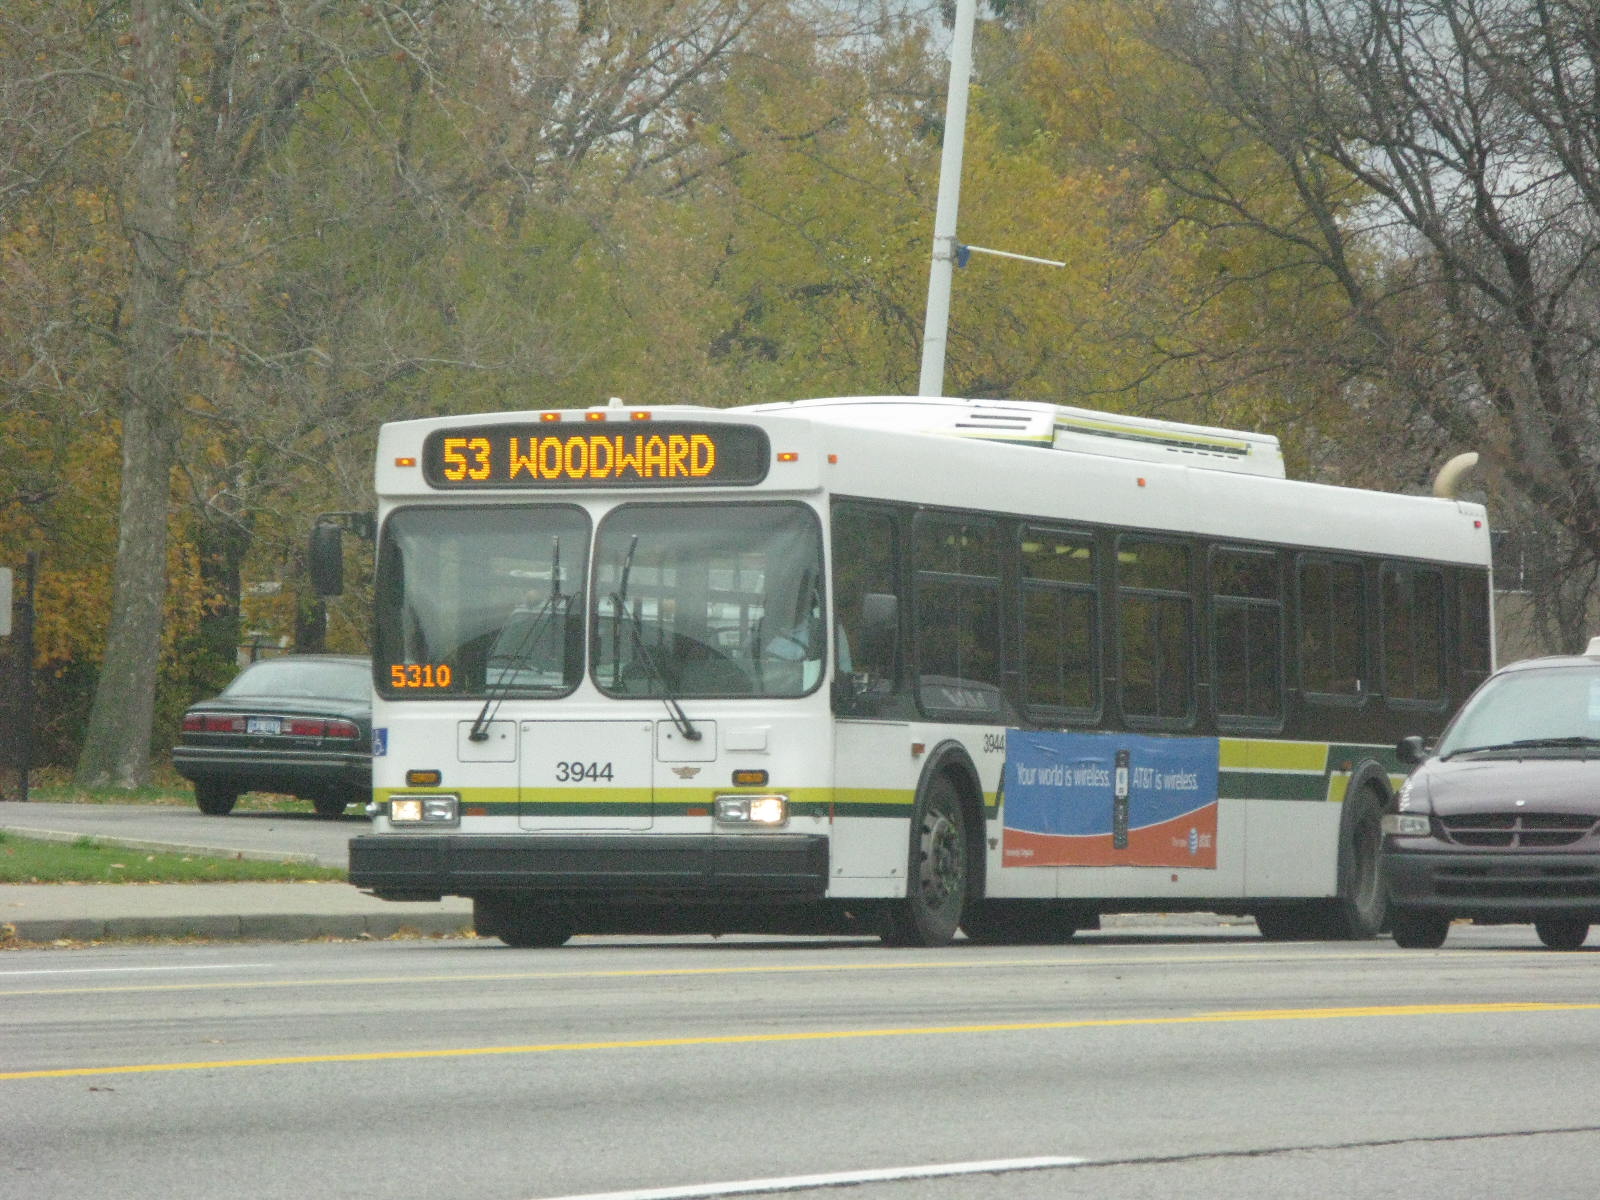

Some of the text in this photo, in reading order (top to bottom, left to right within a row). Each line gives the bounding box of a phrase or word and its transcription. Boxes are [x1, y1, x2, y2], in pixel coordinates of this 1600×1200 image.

[444, 434, 715, 480] 53 WOODWARD
[391, 664, 452, 688] 5310
[983, 733, 1005, 754] 3944
[555, 761, 614, 783] 3944
[1016, 761, 1037, 786] Your
[1038, 764, 1063, 787] world
[1064, 764, 1073, 787] is
[1133, 766, 1155, 789] AT&T
[1155, 768, 1163, 791] is
